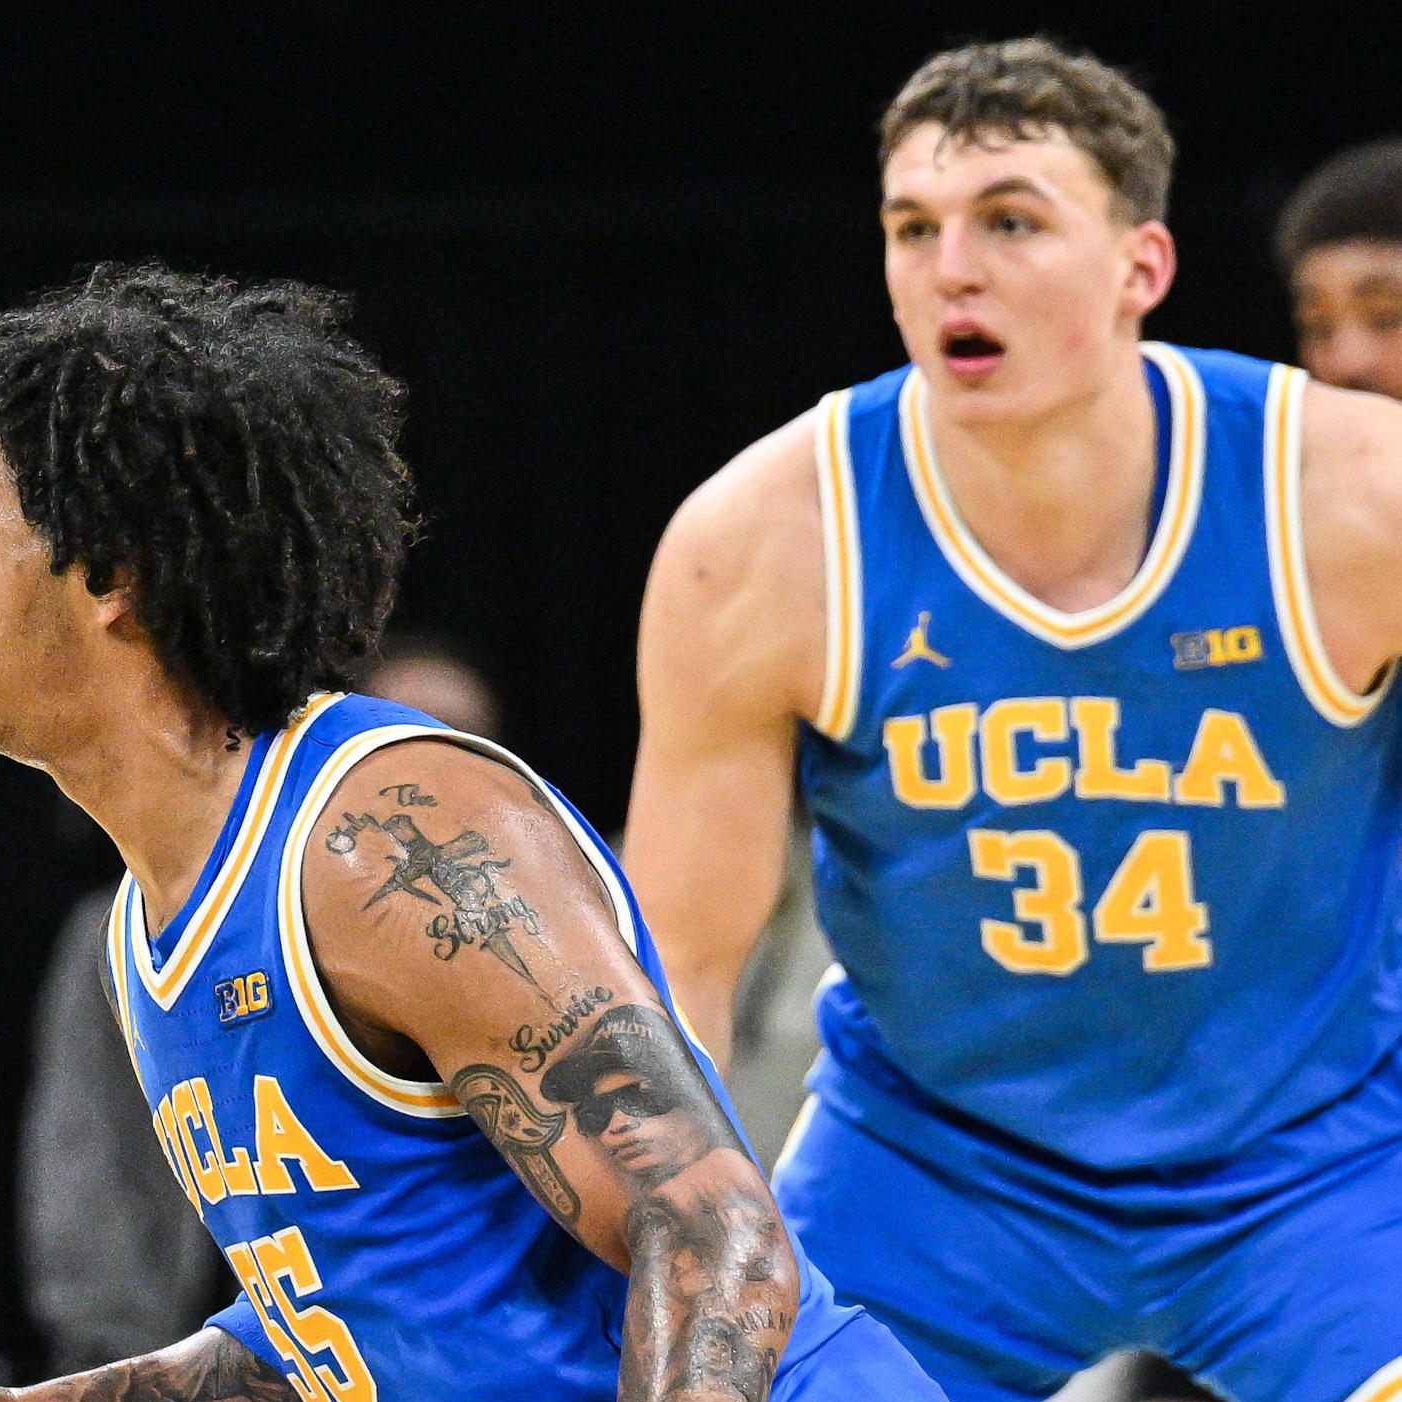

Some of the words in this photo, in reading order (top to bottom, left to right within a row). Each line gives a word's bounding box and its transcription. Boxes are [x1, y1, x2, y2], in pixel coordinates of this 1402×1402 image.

[883, 696, 1286, 810] UCLA
[967, 827, 1214, 975] 34
[152, 1074, 361, 1224] UCLA
